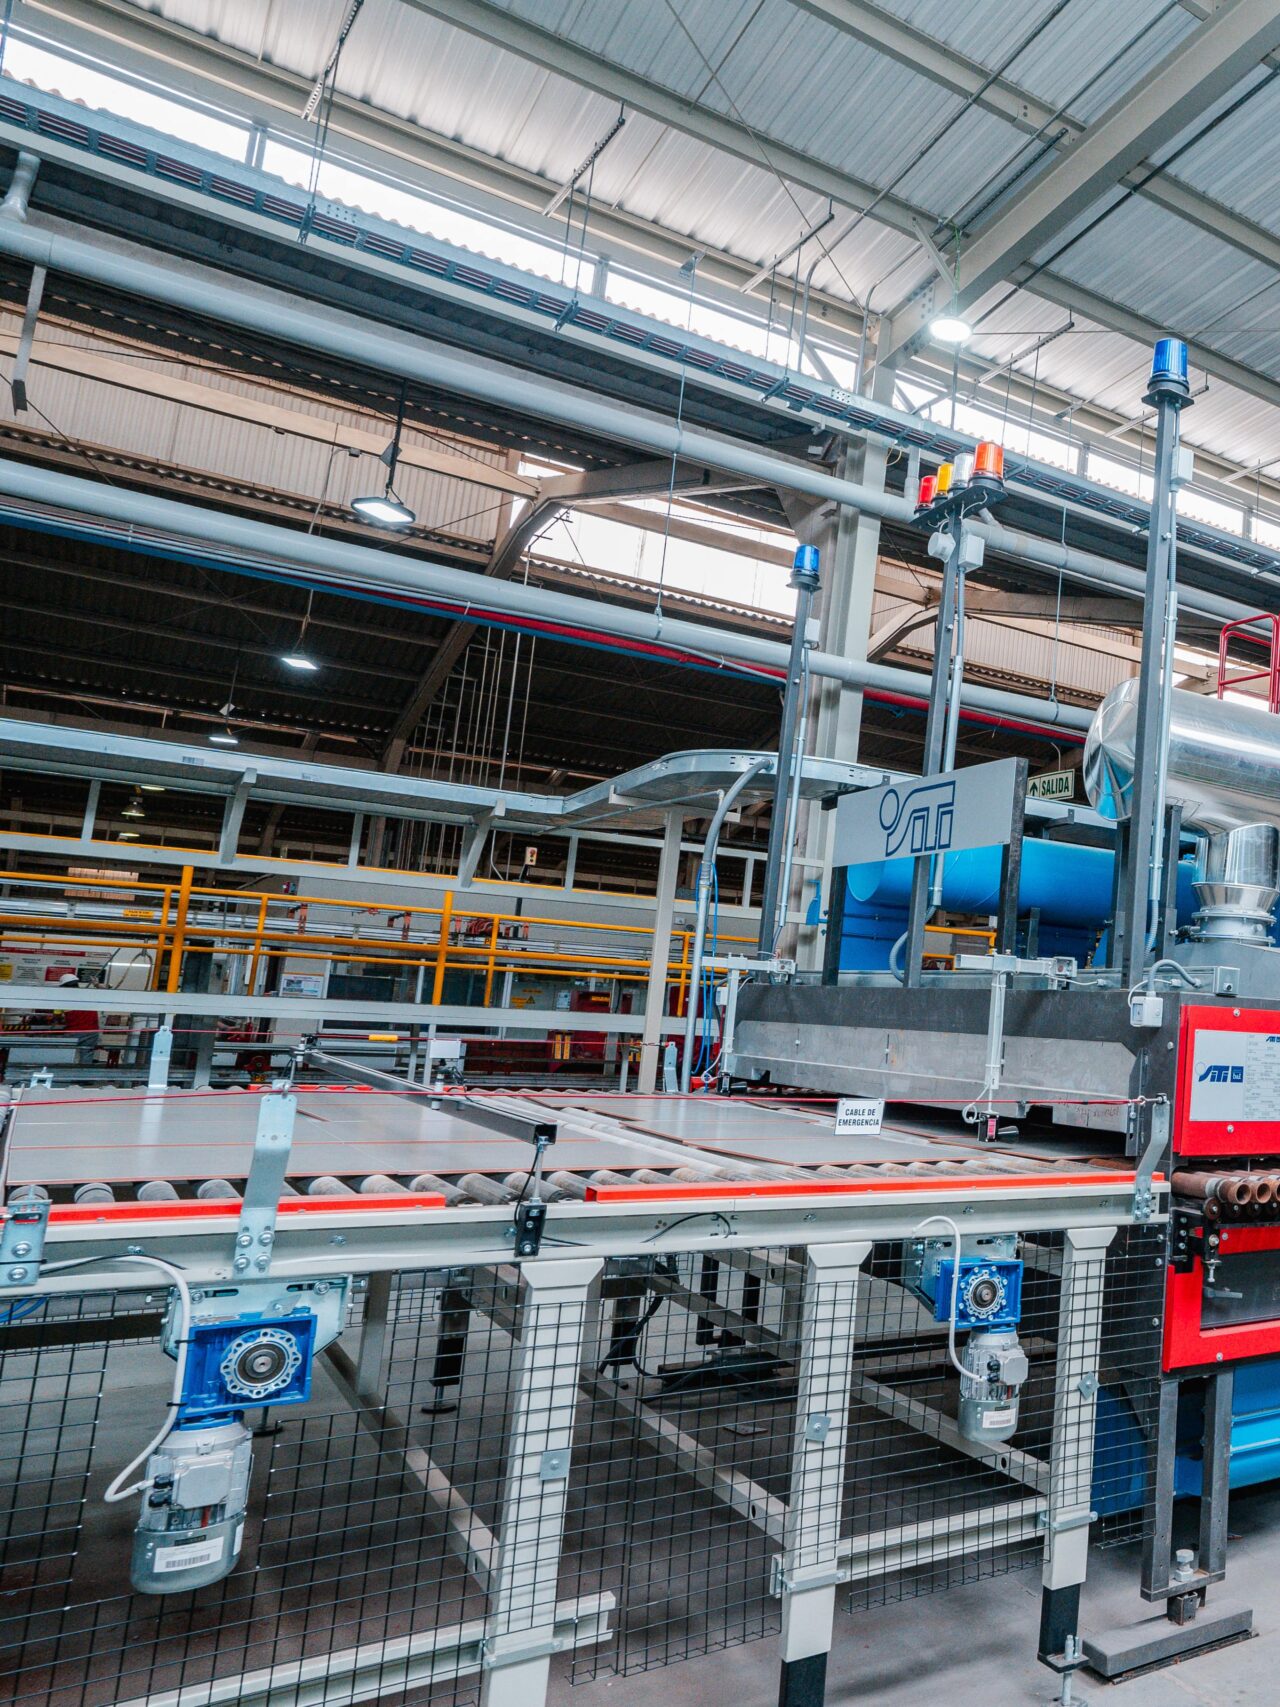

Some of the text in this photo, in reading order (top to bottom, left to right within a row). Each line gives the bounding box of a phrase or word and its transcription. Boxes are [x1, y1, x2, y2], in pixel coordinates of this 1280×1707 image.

[1041, 776, 1070, 796] SALIDA
[867, 1108, 876, 1116] DE
[838, 1118, 880, 1127] EMERGENCIA
